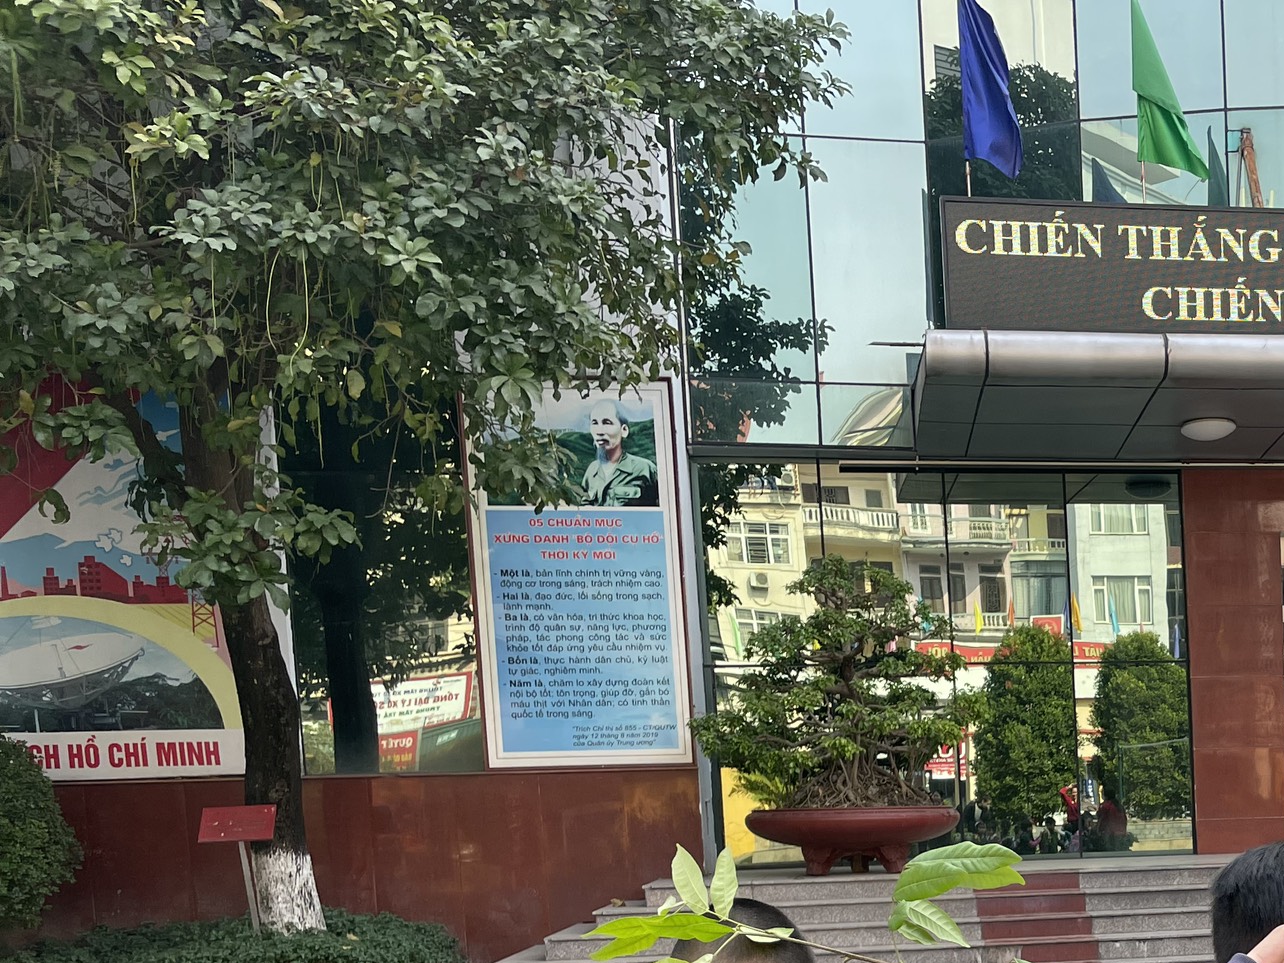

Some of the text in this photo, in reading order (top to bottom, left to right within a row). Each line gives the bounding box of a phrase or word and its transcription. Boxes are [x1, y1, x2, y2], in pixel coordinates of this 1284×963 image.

[955, 211, 1105, 257] CHIẾN
[1118, 216, 1282, 263] THẮNG
[1142, 277, 1284, 322] CHIẾN
[529, 518, 543, 528] 05
[547, 515, 591, 528] CHUẨN
[534, 535, 569, 544] DANH
[500, 570, 518, 579] Một
[536, 569, 553, 578] bản
[575, 569, 600, 577] chính
[500, 579, 522, 589] động
[539, 580, 562, 589] trong
[591, 579, 612, 587] trách
[615, 579, 641, 588] nhiệm
[503, 592, 518, 600] Hai
[535, 592, 551, 601] đạo
[592, 588, 612, 601] sống
[616, 592, 638, 601] trong
[503, 602, 522, 610] lành
[534, 613, 544, 621] có
[600, 613, 620, 621] thức
[623, 613, 644, 621] khoa
[529, 623, 540, 632] độ
[544, 623, 566, 633] quân
[632, 623, 666, 633] phương
[556, 633, 583, 643] phong
[589, 633, 610, 643] công
[615, 633, 629, 641] tác
[635, 633, 645, 641] và
[650, 633, 666, 641] sức
[532, 643, 543, 652] tốt
[547, 644, 563, 653] đáp
[567, 643, 584, 653] ứng
[588, 644, 603, 653] yêu
[606, 642, 622, 651] cầu
[625, 643, 652, 652] nhiệm
[508, 656, 527, 665] Bốn
[544, 656, 565, 665] thực
[569, 656, 591, 664] hành
[595, 656, 611, 664] dân
[652, 655, 668, 664] luật
[508, 667, 517, 676] tự
[544, 667, 576, 676] nghiêm
[510, 679, 531, 688] Năm
[548, 679, 573, 687] chăm
[576, 679, 584, 687] lo
[587, 679, 602, 688] xây
[606, 679, 628, 688] dựng
[631, 678, 653, 686] đoàn
[657, 677, 670, 686] kết
[510, 690, 523, 698] nội
[526, 690, 537, 698] bộ
[556, 689, 570, 697] tôn
[601, 689, 619, 698] giúp
[511, 700, 530, 708] máu
[534, 700, 547, 708] thịt
[551, 700, 565, 708] với
[568, 699, 592, 707] Nhân
[618, 699, 628, 707] có
[651, 697, 670, 706] thần
[511, 709, 533, 719] quốc
[535, 709, 543, 718] tế
[546, 710, 569, 719] trong
[68, 735, 100, 769] HỒ
[108, 737, 149, 768] CHÍ
[156, 741, 221, 767] MINH
